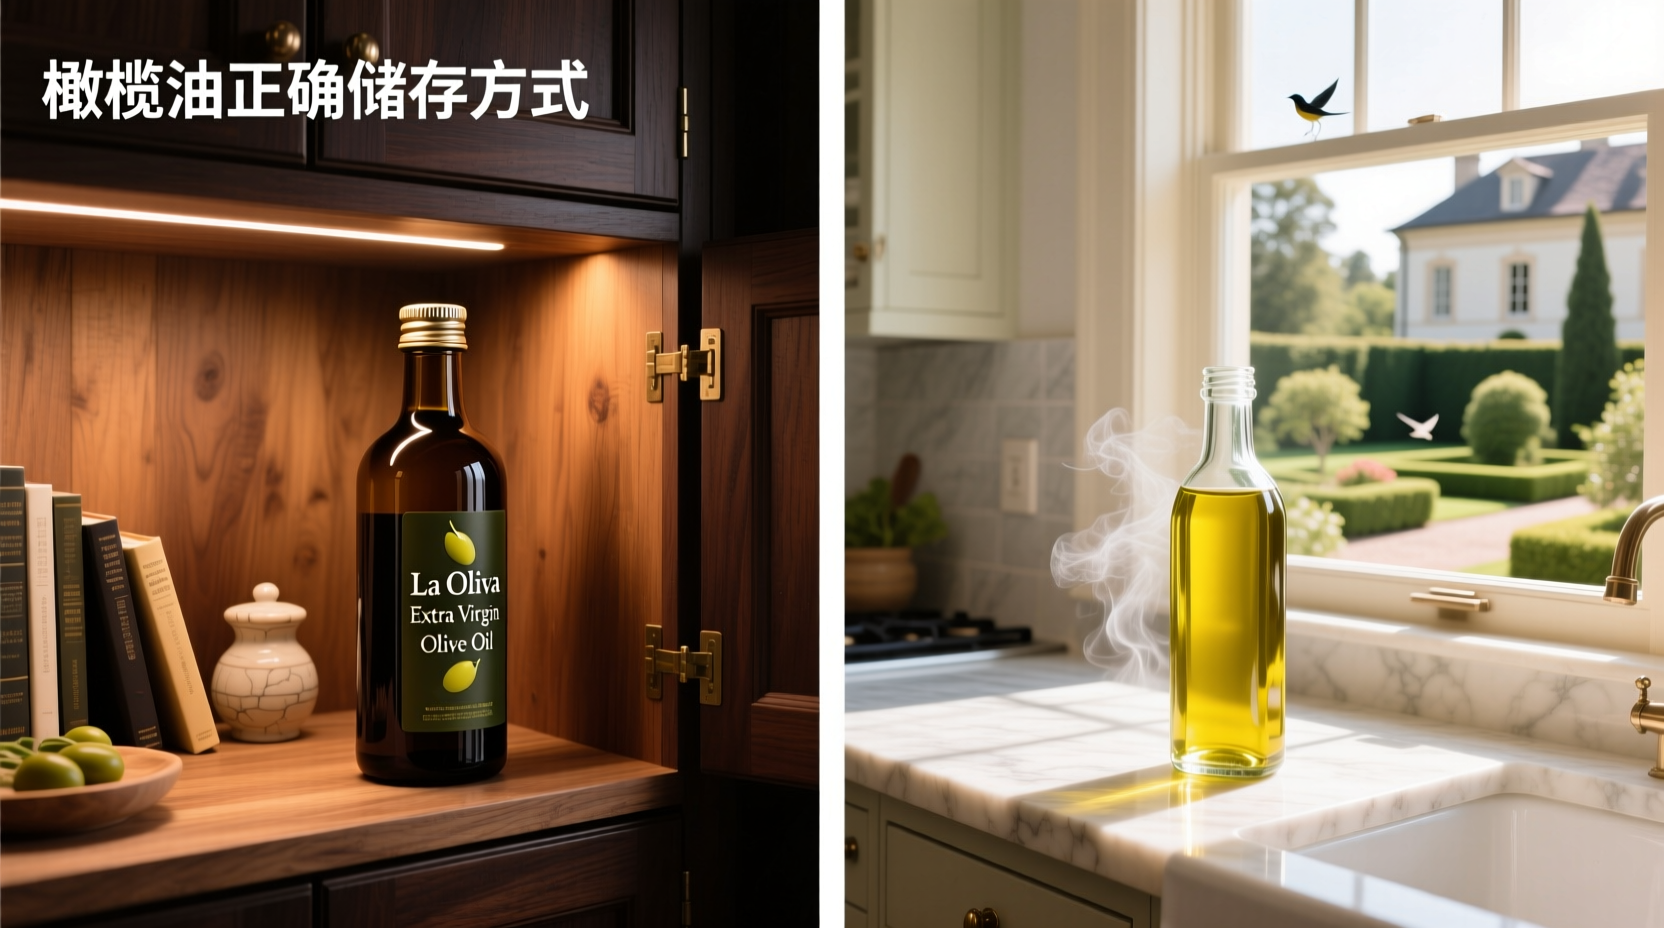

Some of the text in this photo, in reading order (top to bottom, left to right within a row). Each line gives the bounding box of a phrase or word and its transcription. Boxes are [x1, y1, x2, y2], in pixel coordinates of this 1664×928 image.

[410, 569, 501, 597] La Oliva
[410, 603, 500, 627] Extra Virgin
[420, 630, 494, 654] Olive Oil
